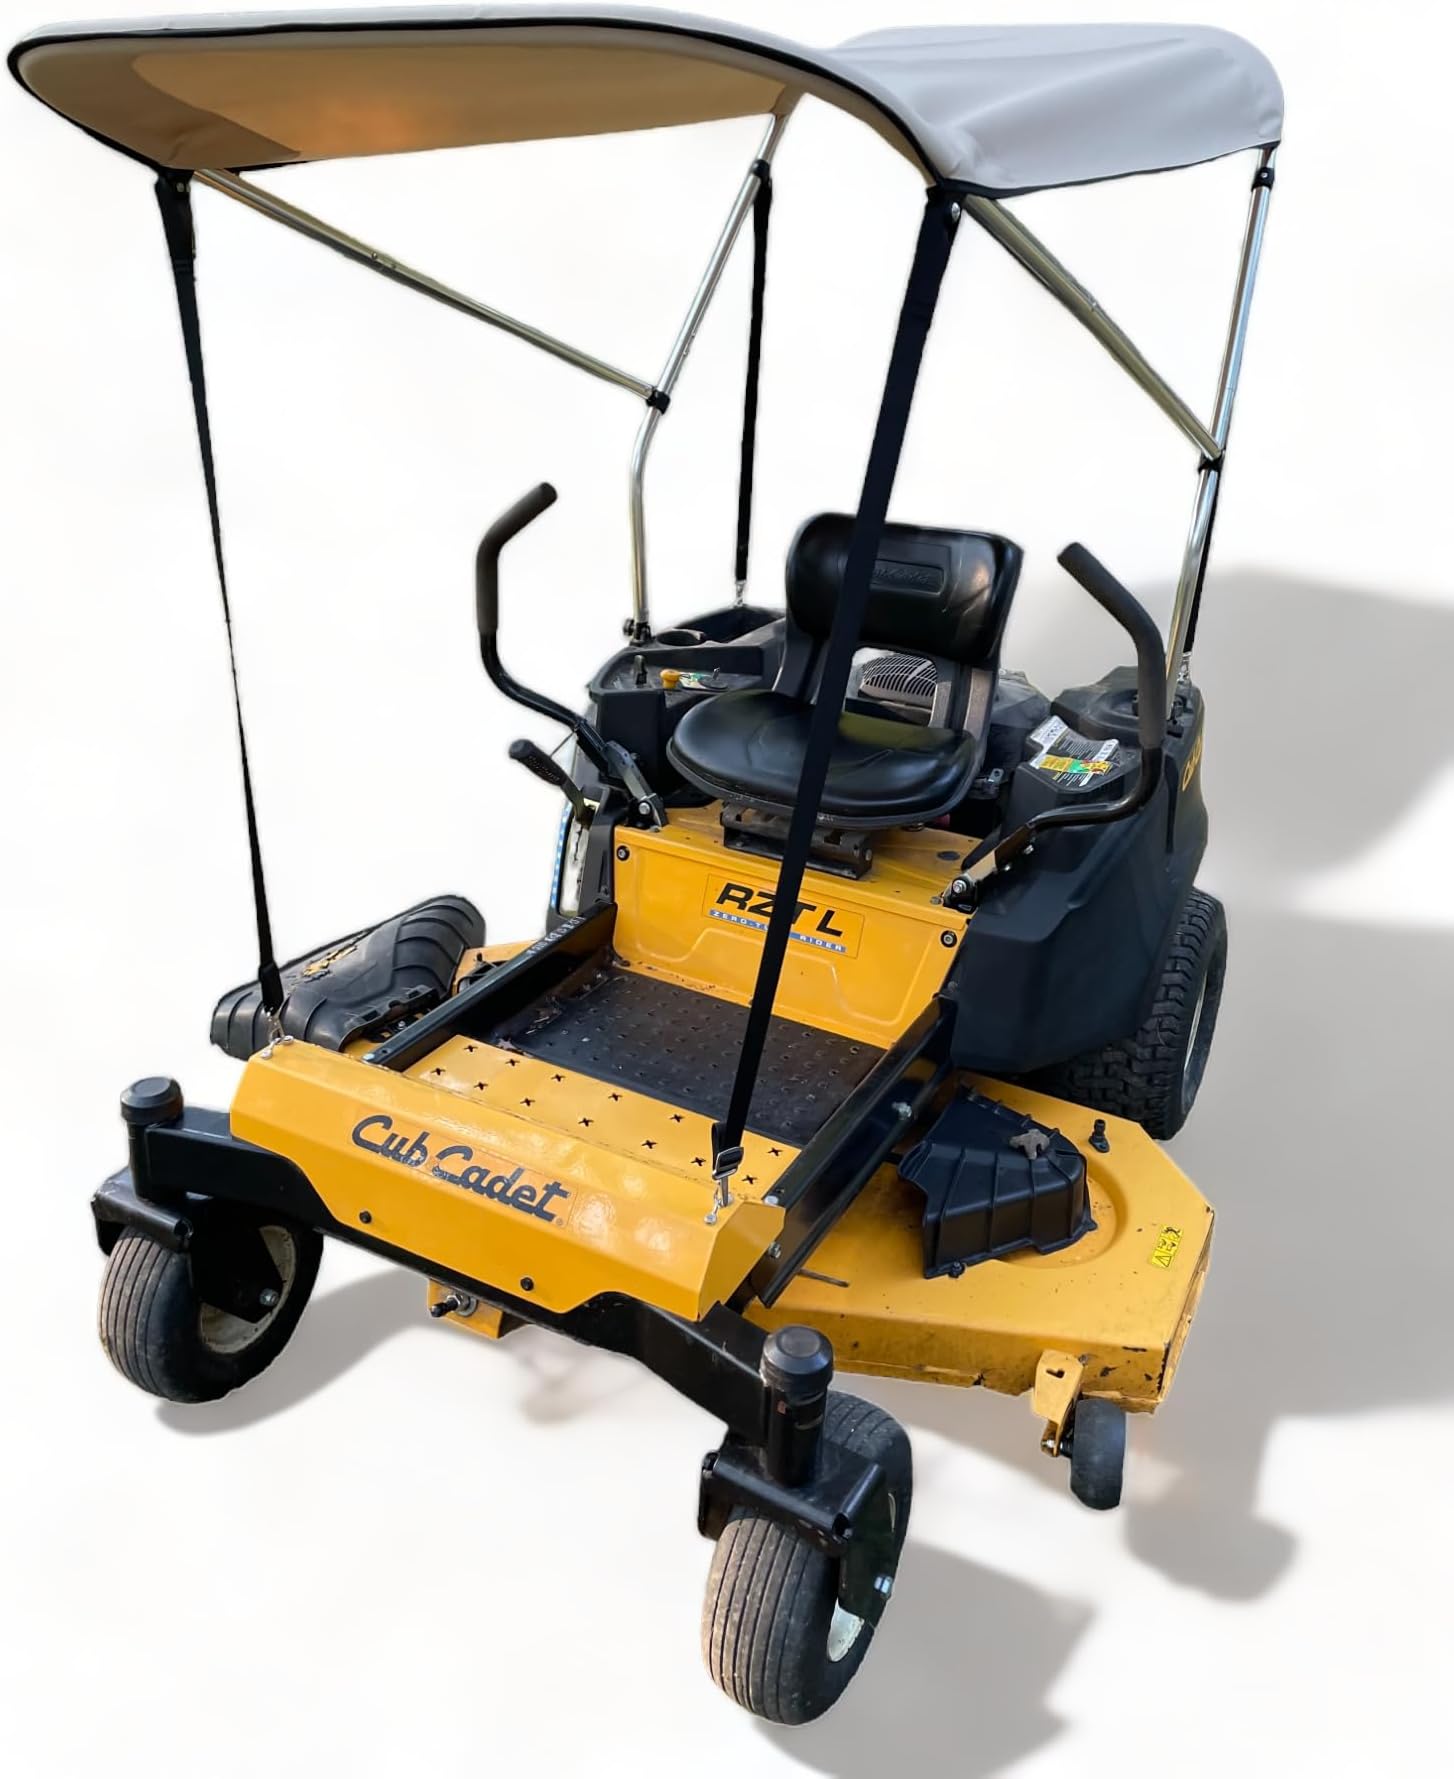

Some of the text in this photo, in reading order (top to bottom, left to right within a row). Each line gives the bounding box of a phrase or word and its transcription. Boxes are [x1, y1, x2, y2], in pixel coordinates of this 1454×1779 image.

[800, 935, 842, 951] RIDER
[352, 1114, 570, 1222] Cub Cadet
